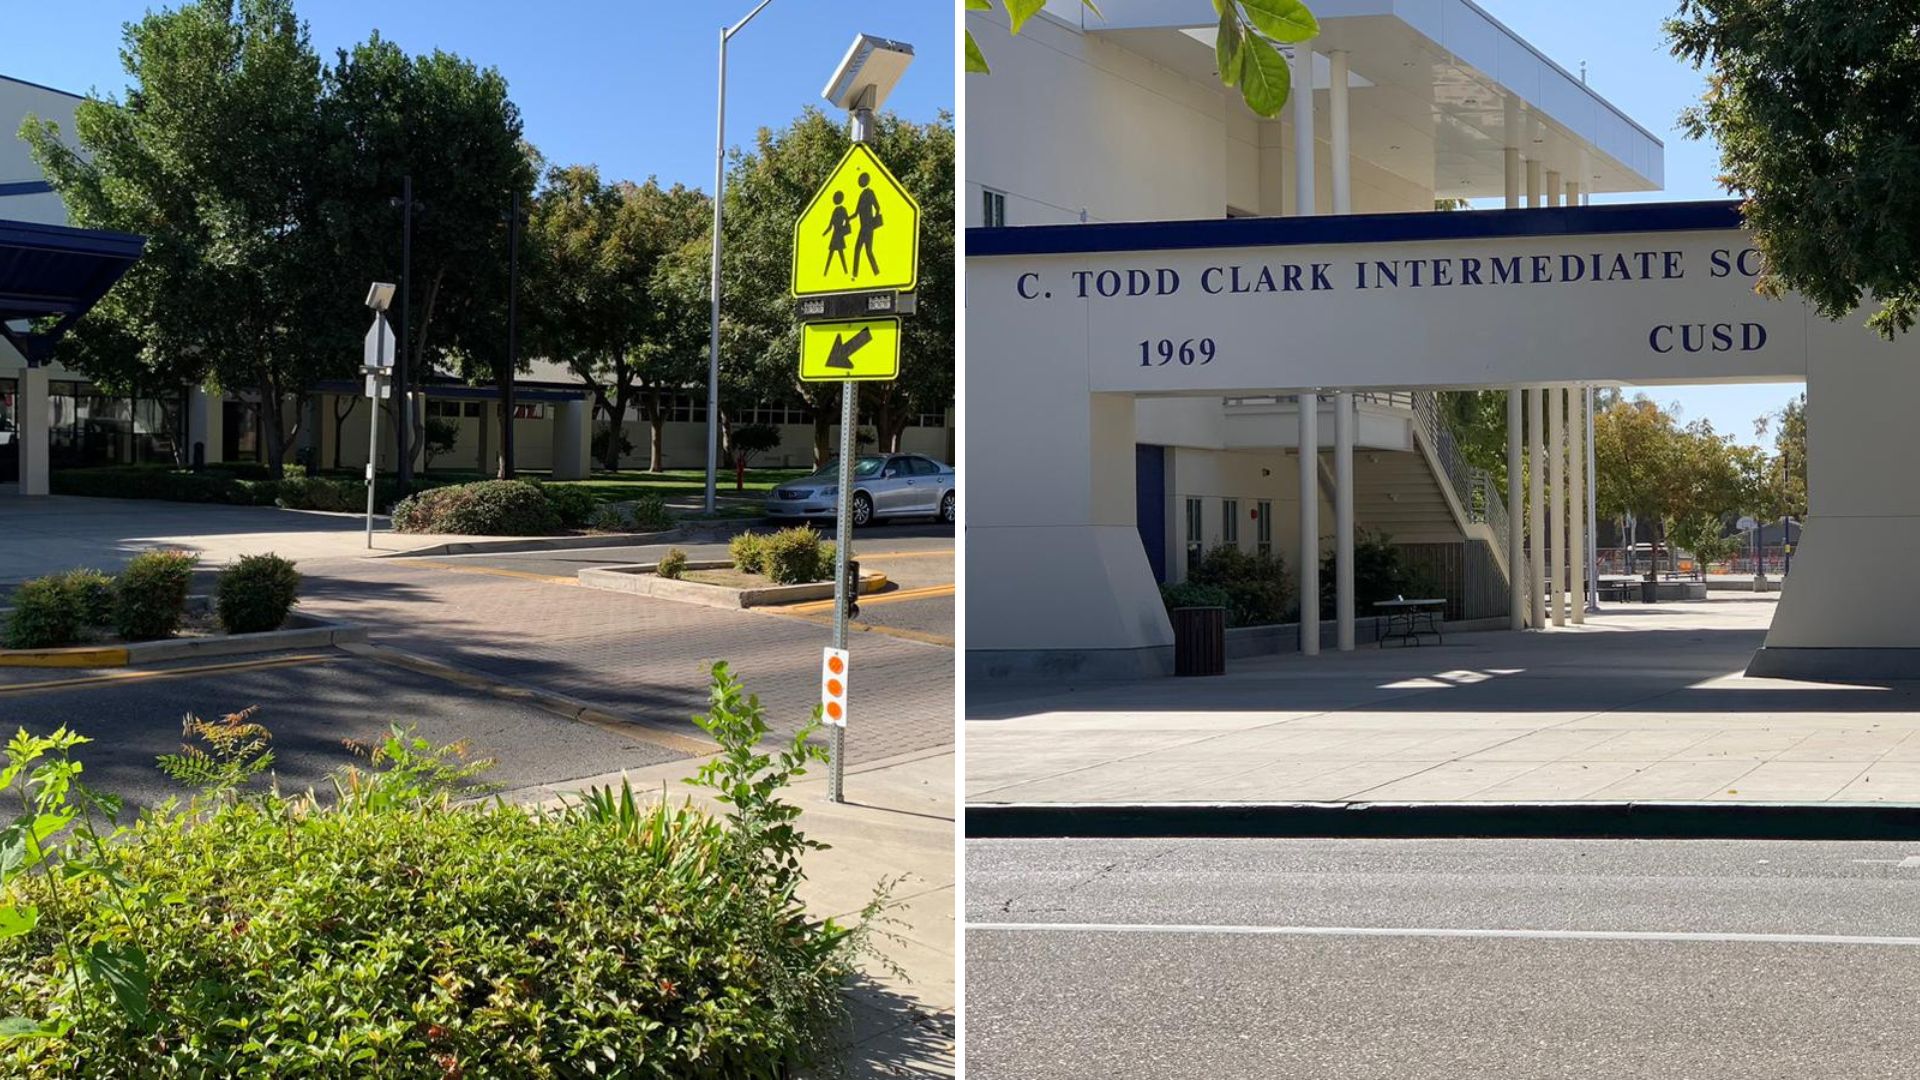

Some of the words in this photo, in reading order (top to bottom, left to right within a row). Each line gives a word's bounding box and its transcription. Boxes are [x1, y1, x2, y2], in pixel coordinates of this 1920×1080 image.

[1016, 272, 1052, 299] C.
[1072, 269, 1180, 299] TODD
[1201, 263, 1334, 294] CLARK
[1355, 250, 1685, 290] INTERMEDIATE
[1139, 337, 1217, 368] 1969
[1649, 322, 1768, 353] CUSD
